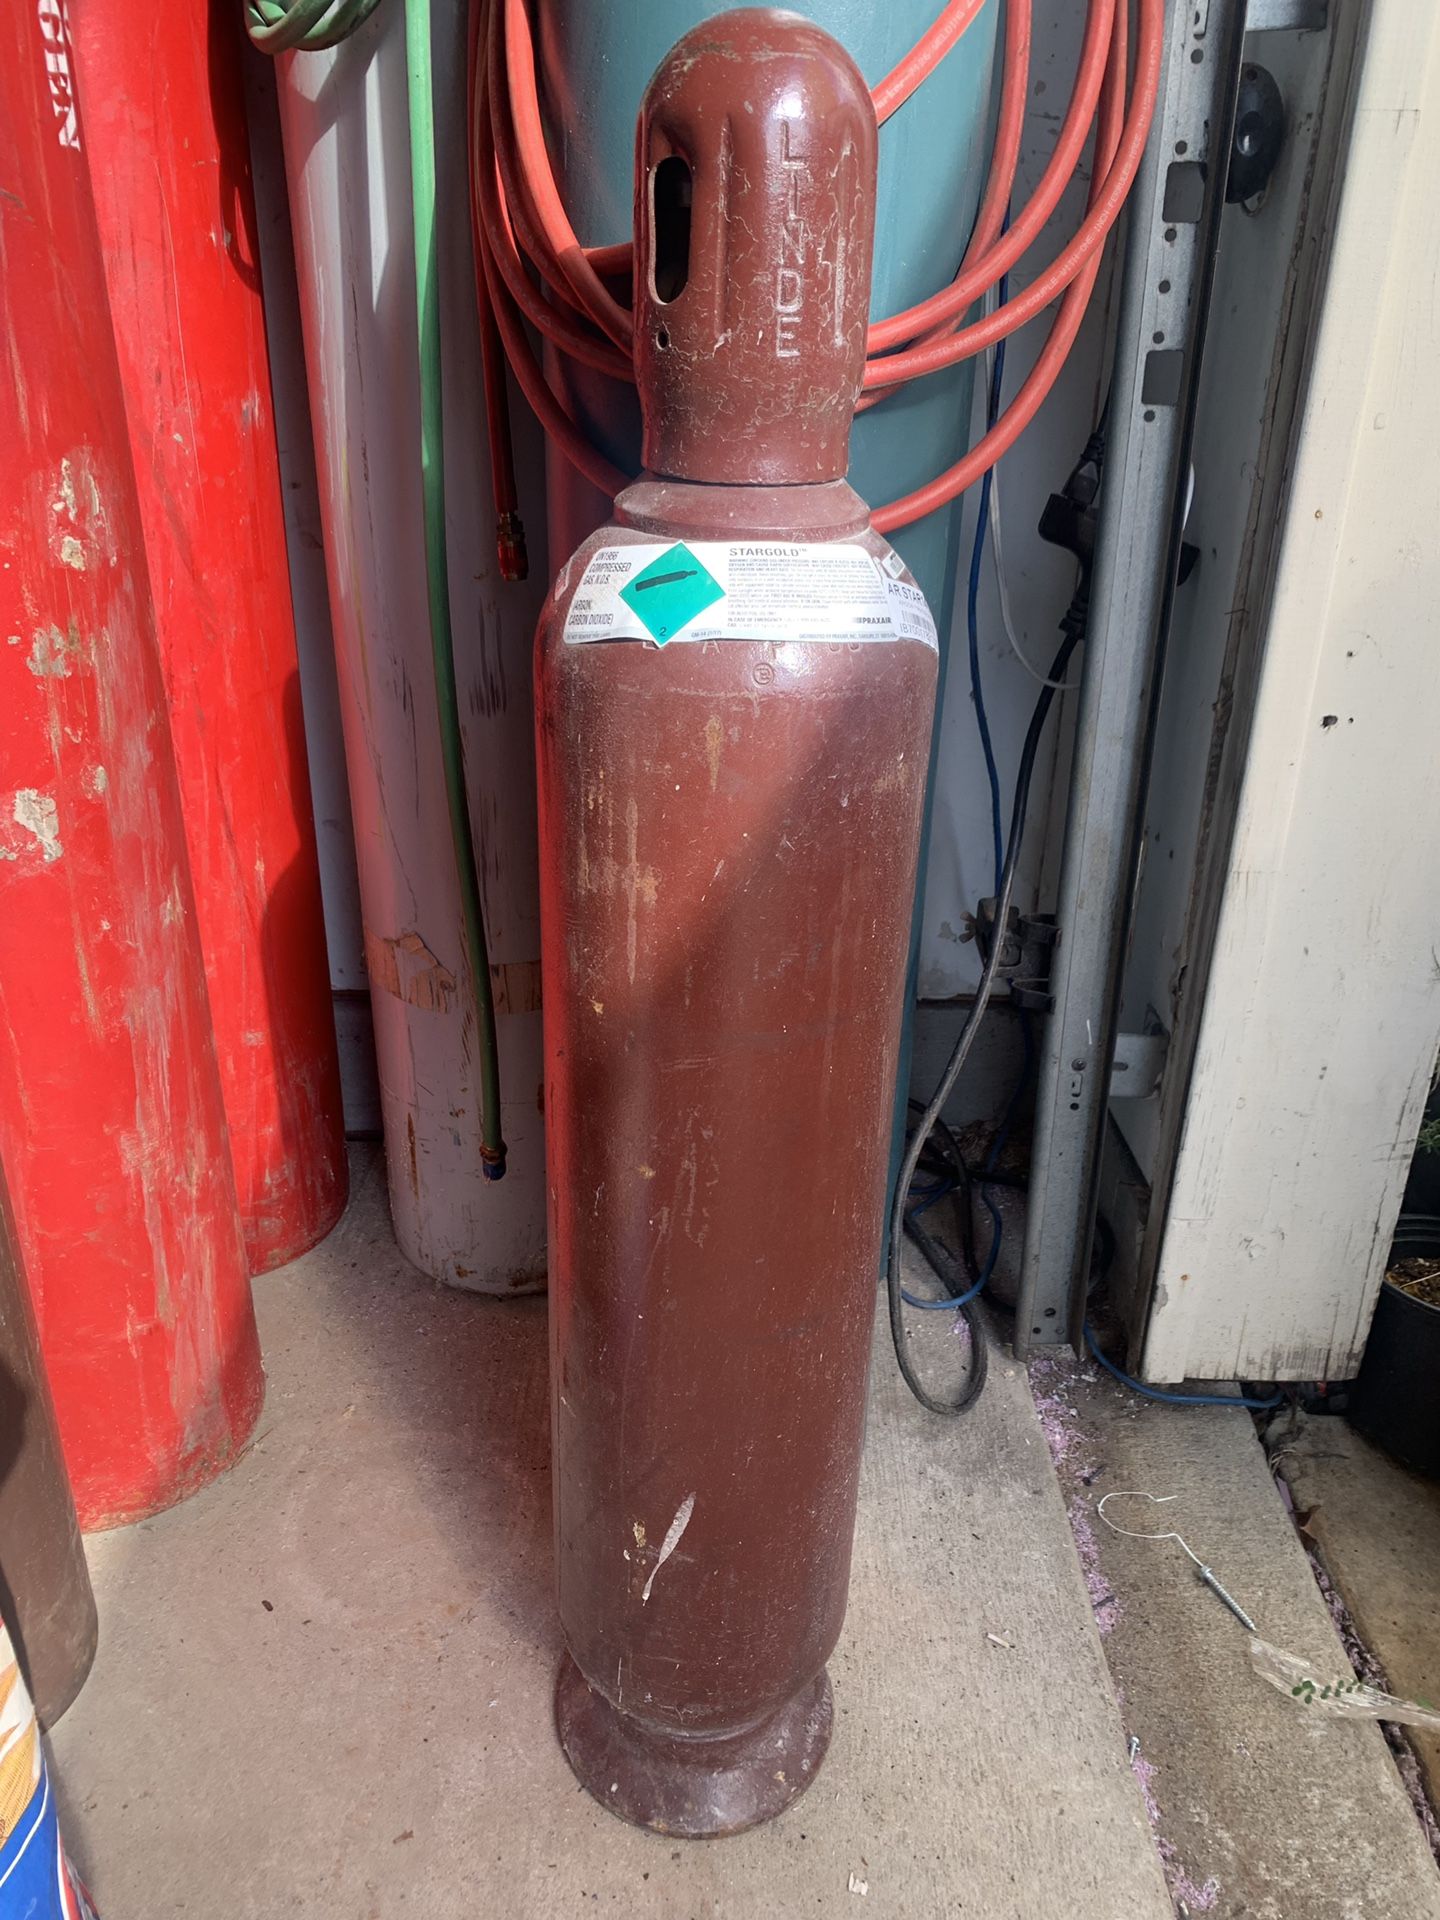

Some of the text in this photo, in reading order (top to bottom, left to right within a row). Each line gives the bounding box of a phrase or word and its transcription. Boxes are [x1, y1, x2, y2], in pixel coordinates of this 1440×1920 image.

[776, 119, 806, 358] LINDE
[1057, 252, 1080, 277] WITH
[589, 562, 632, 573] COMPRESSED
[660, 627, 667, 636] 2
